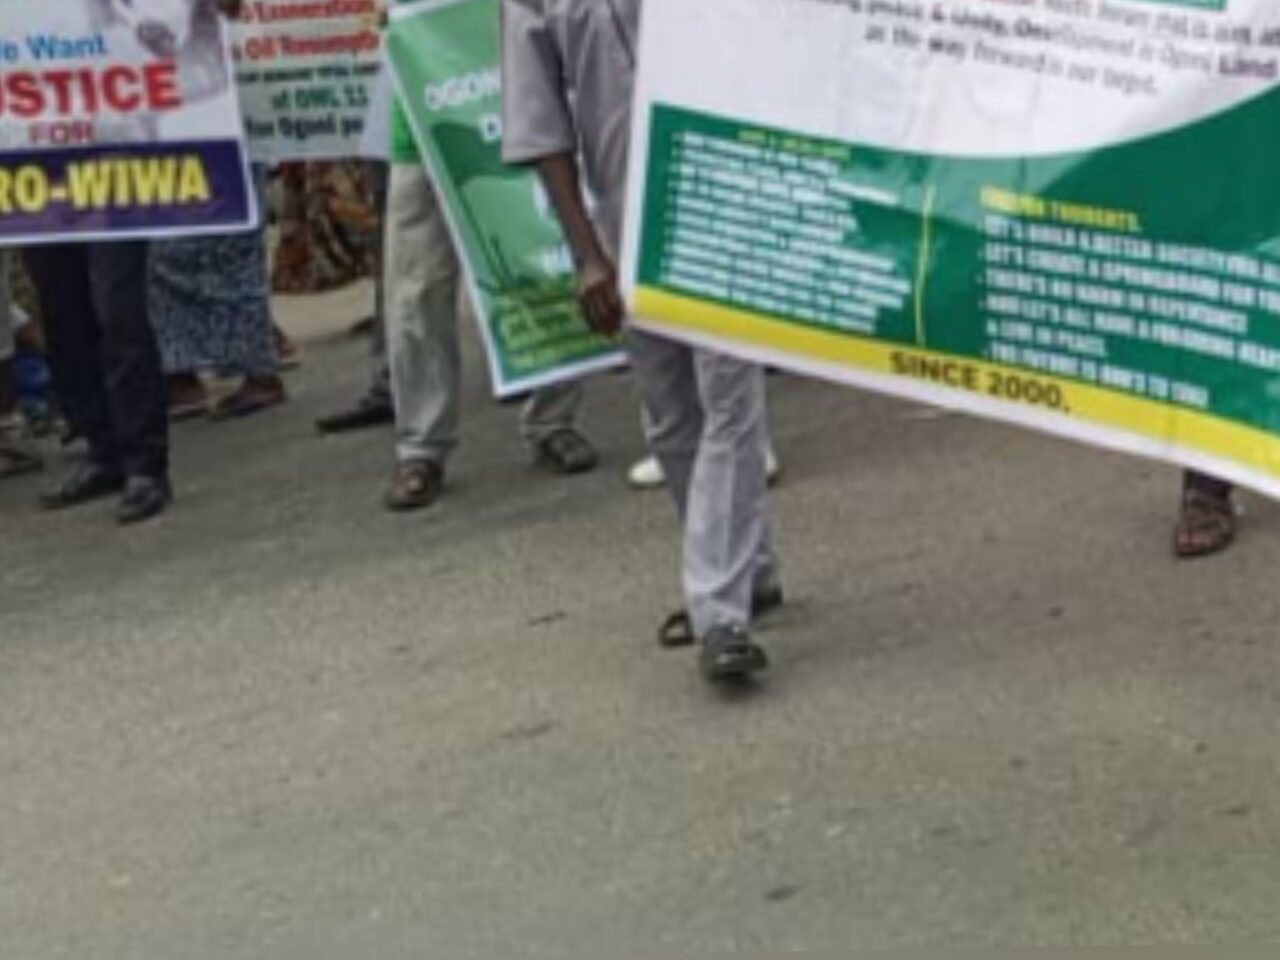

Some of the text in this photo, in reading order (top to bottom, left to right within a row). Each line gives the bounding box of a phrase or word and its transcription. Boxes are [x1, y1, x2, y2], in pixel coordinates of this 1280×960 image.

[28, 34, 109, 61] Want
[0, 59, 183, 118] STICE
[29, 120, 93, 144] FOR
[889, 349, 1072, 417] SINCE 2000.
